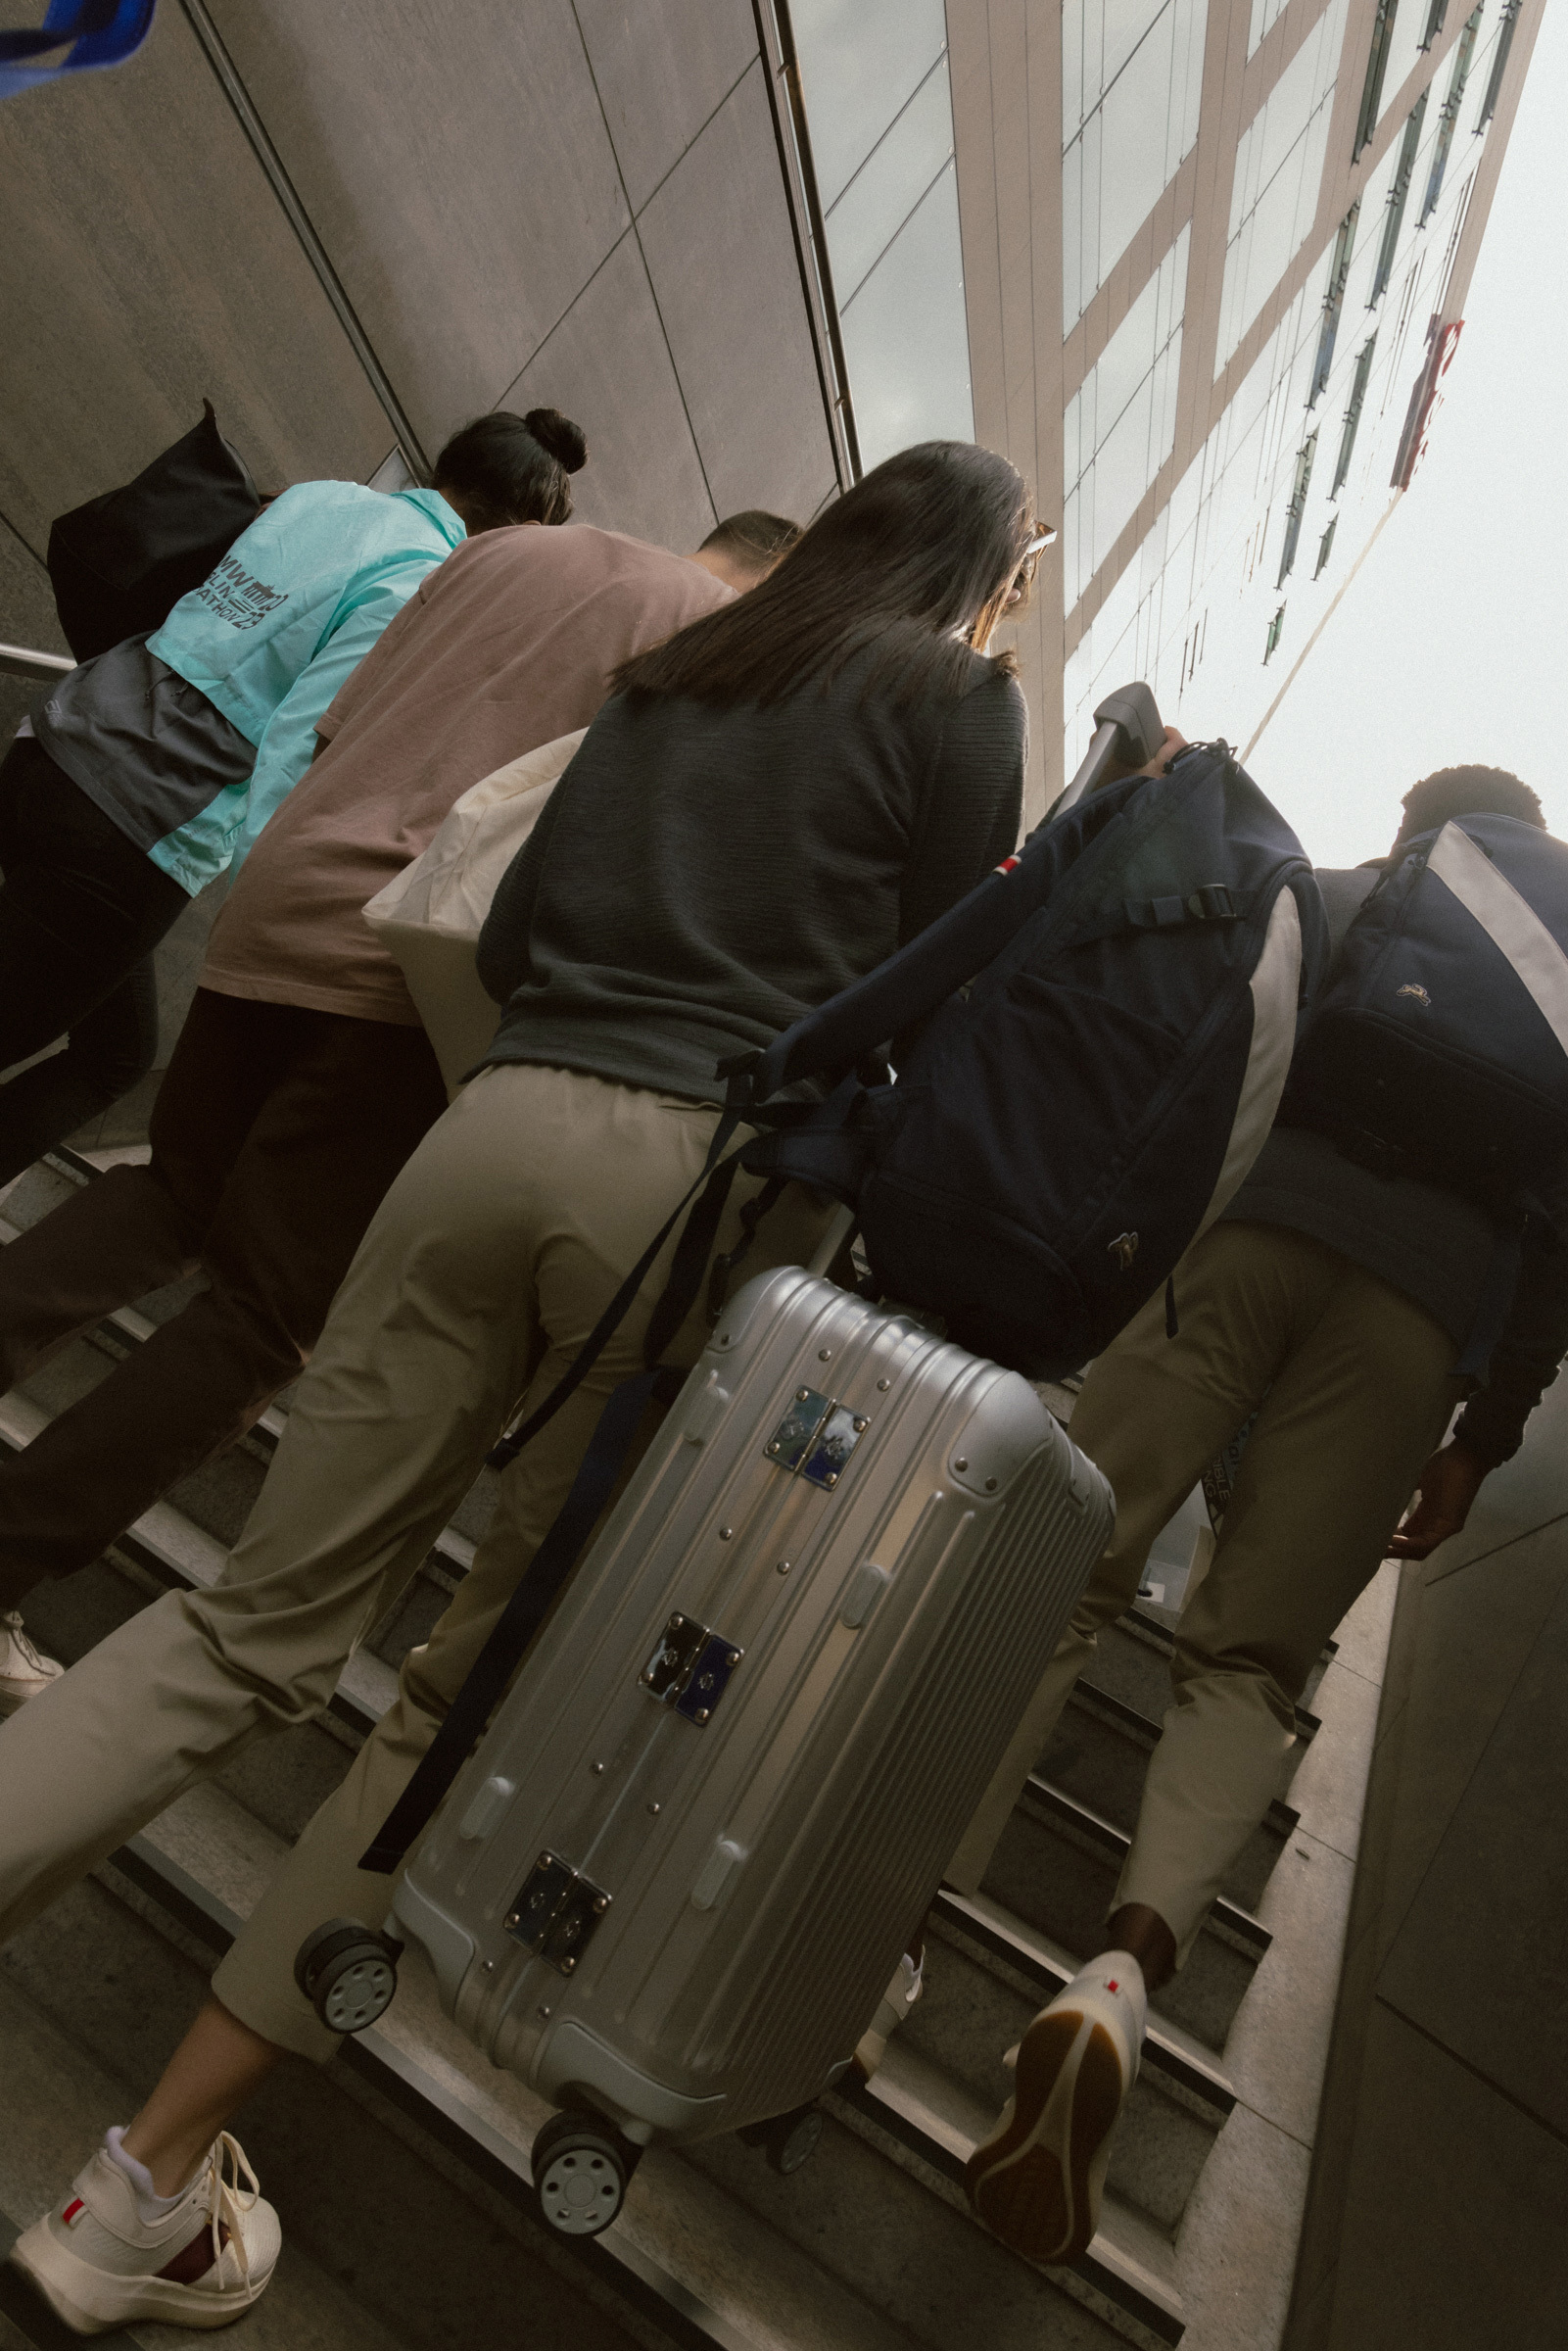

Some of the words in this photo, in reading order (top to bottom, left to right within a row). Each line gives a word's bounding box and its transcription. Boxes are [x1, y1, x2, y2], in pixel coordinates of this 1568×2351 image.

[208, 571, 235, 600] LIN
[219, 554, 255, 588] MW
[195, 583, 241, 622] ATHON
[232, 611, 265, 630] 23
[1214, 1453, 1231, 1501] IBLE
